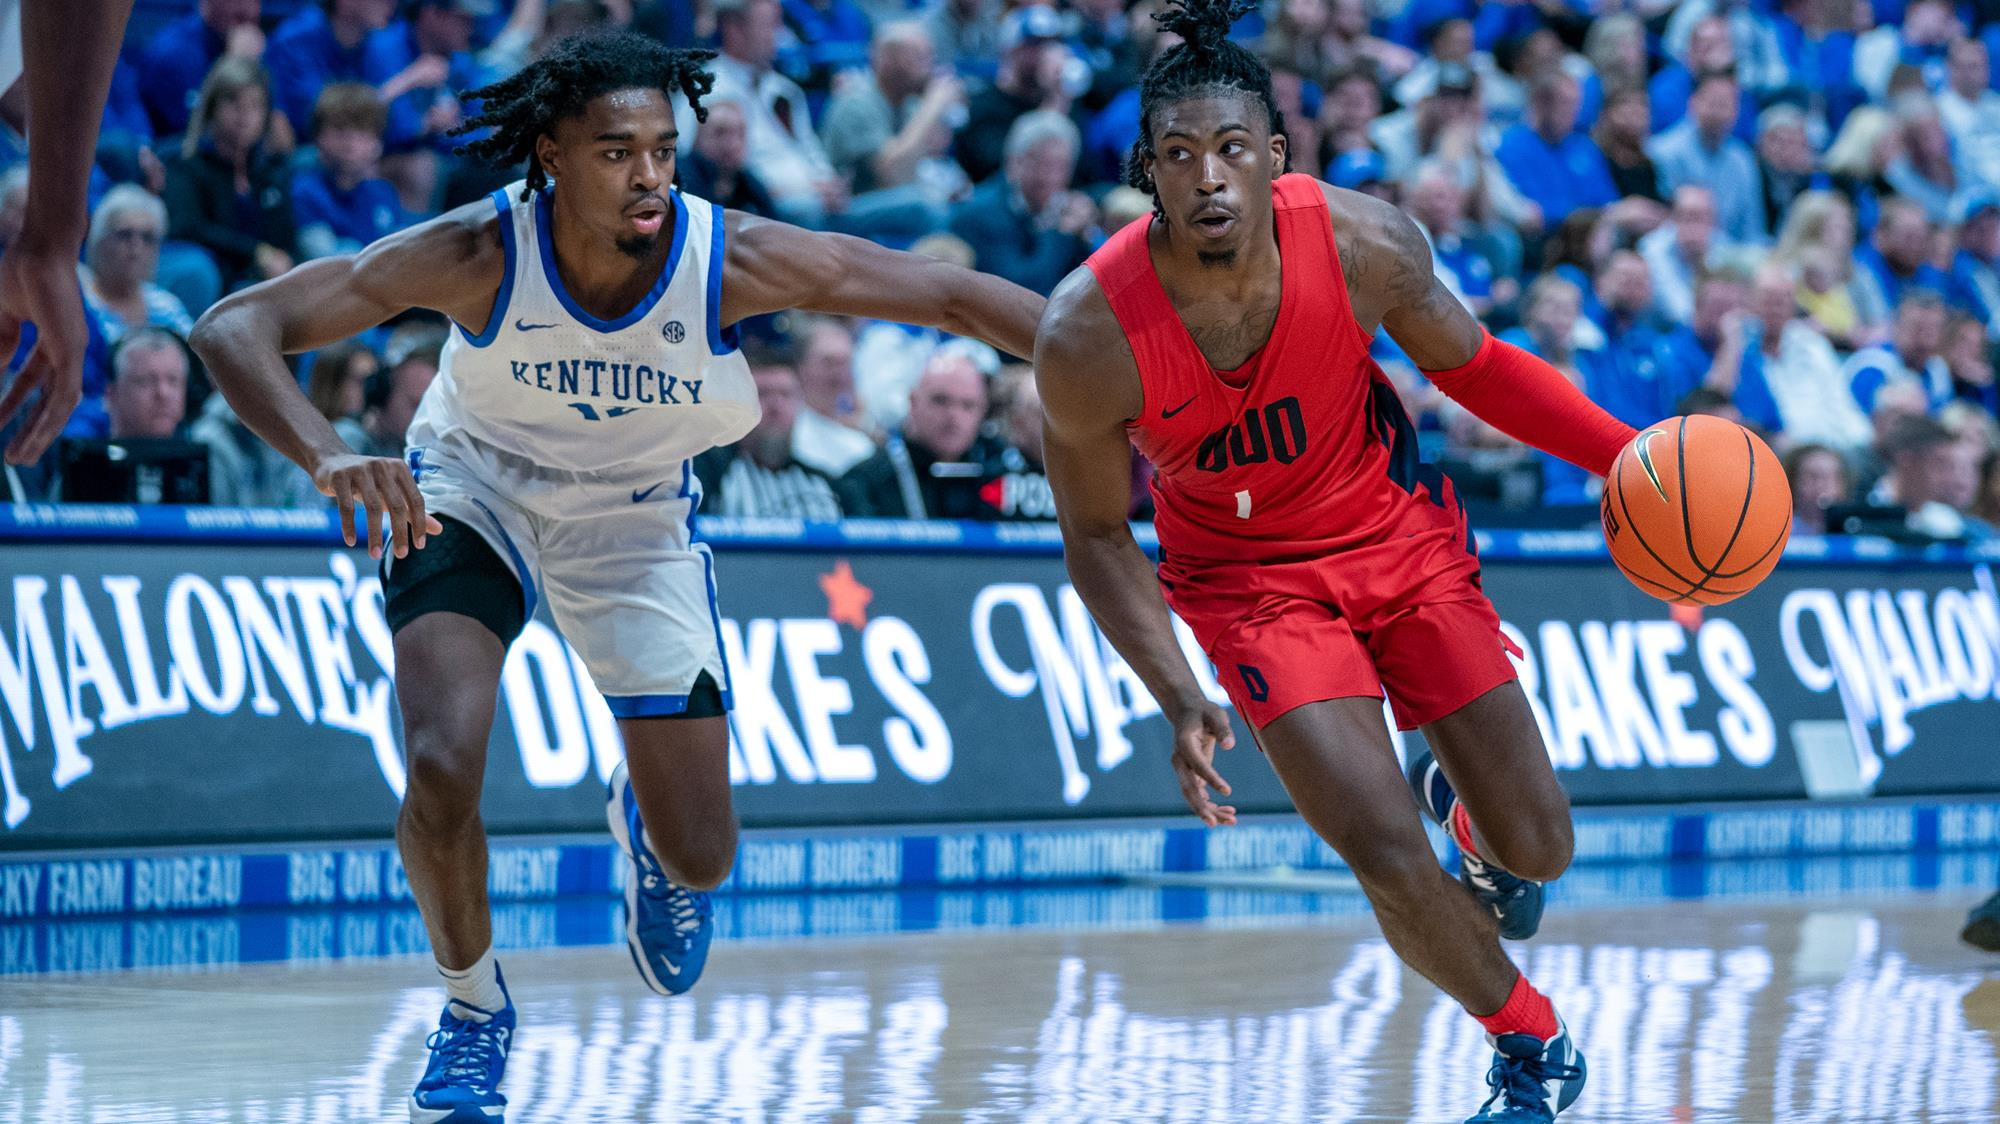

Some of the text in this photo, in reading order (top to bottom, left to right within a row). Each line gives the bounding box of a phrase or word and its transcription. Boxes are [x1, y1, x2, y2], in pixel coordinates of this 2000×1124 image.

[663, 321, 685, 343] SEC
[511, 359, 702, 404] KENTUCKY
[1237, 663, 1269, 703] D
[0, 855, 241, 916] KY FARM BUREAU
[289, 852, 335, 902] BIG
[341, 850, 380, 901] ON
